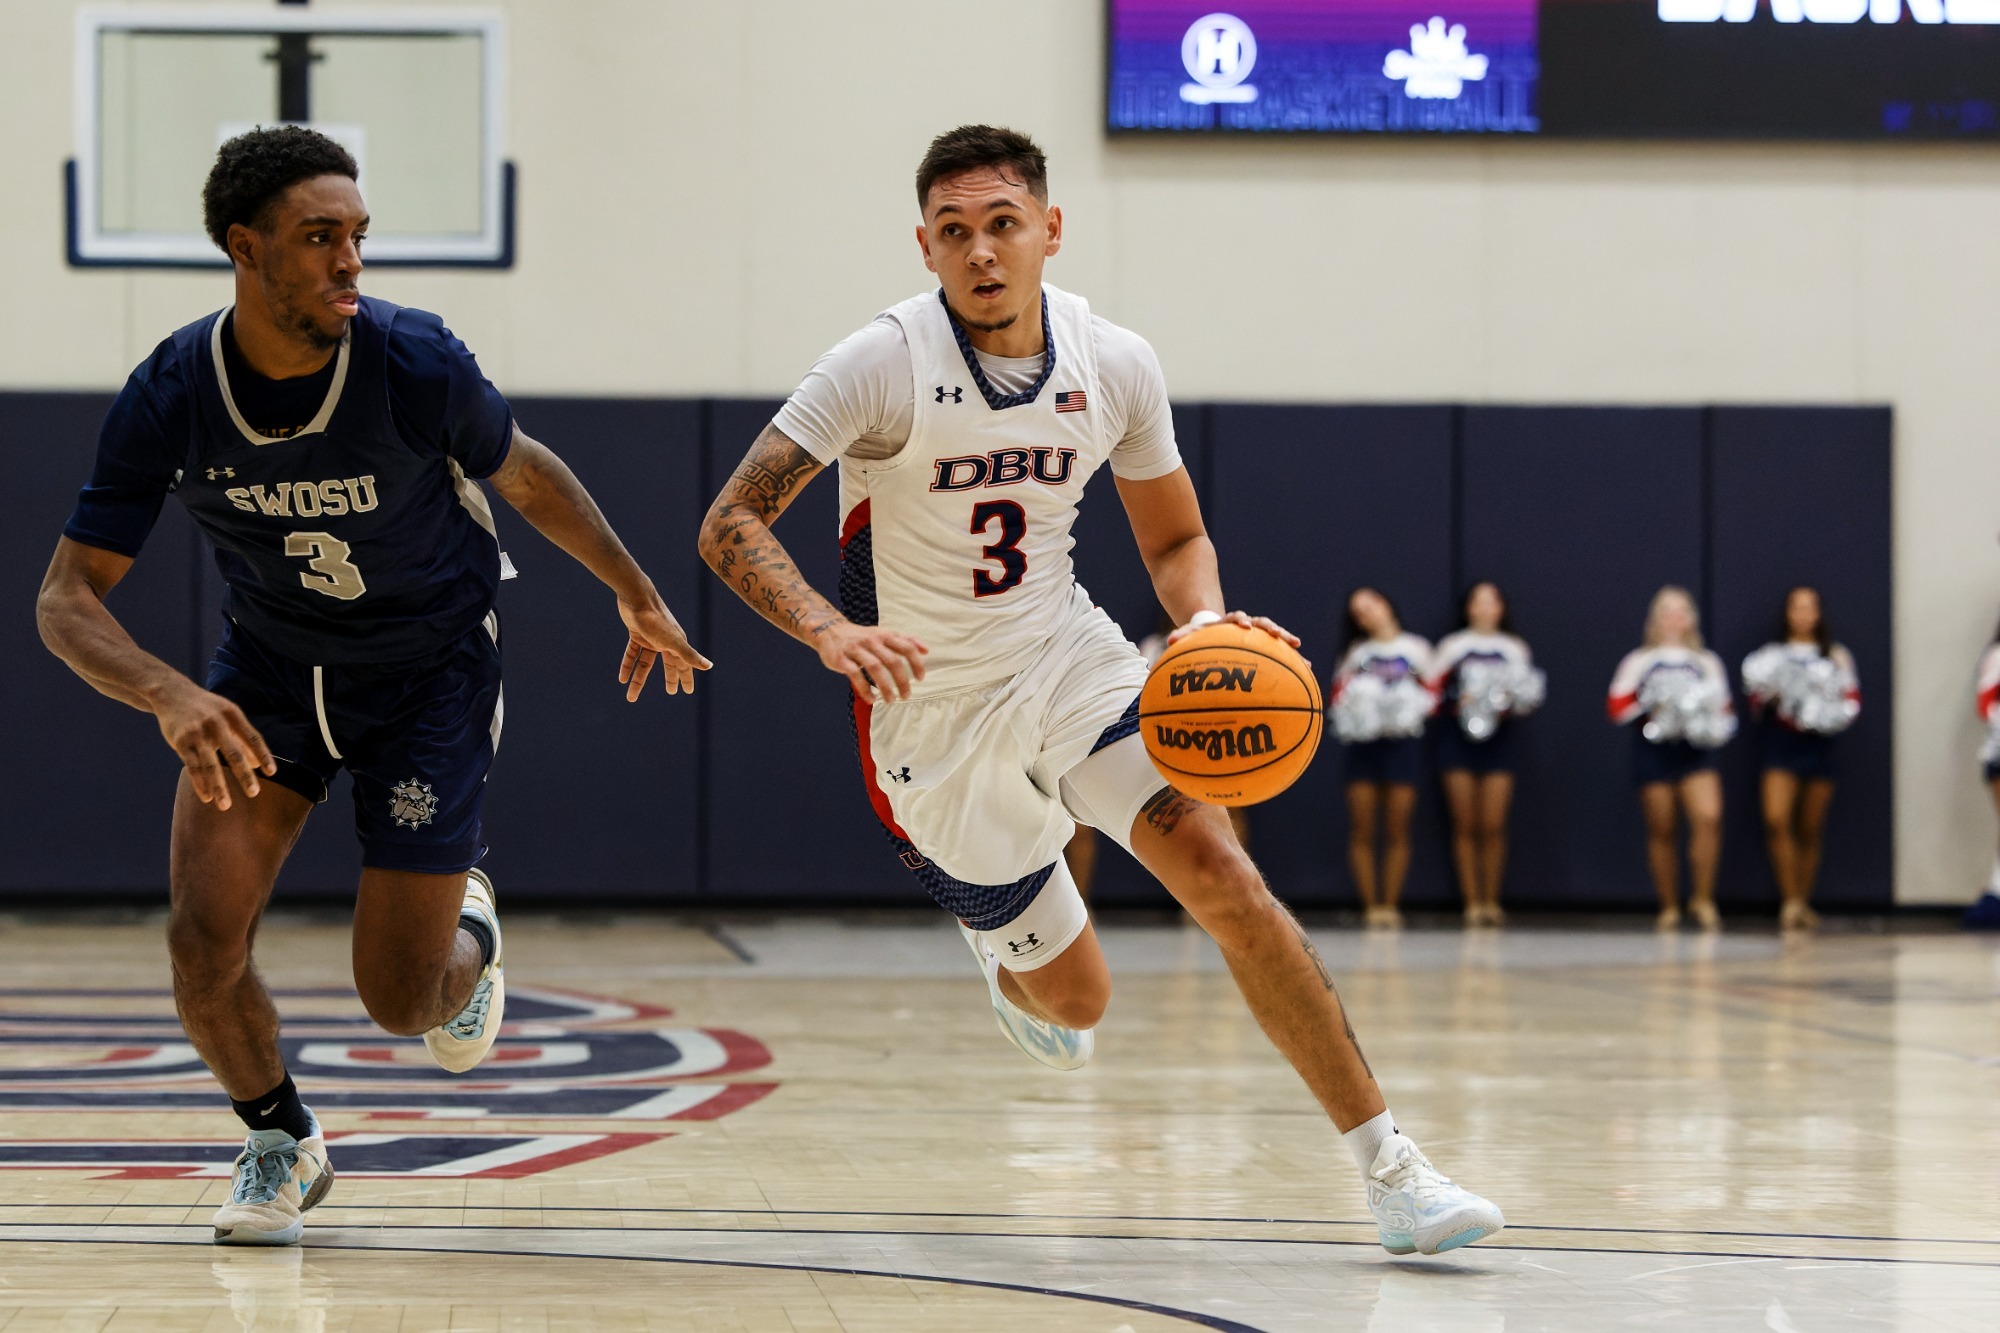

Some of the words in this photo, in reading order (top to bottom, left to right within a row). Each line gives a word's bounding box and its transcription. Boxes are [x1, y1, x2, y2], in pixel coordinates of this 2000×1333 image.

[929, 447, 1077, 492] DBU
[225, 475, 379, 517] SWOSU
[283, 531, 367, 600] 3
[970, 499, 1028, 598] 3
[1169, 666, 1257, 698] NCAA
[1156, 722, 1278, 761] Wilson
